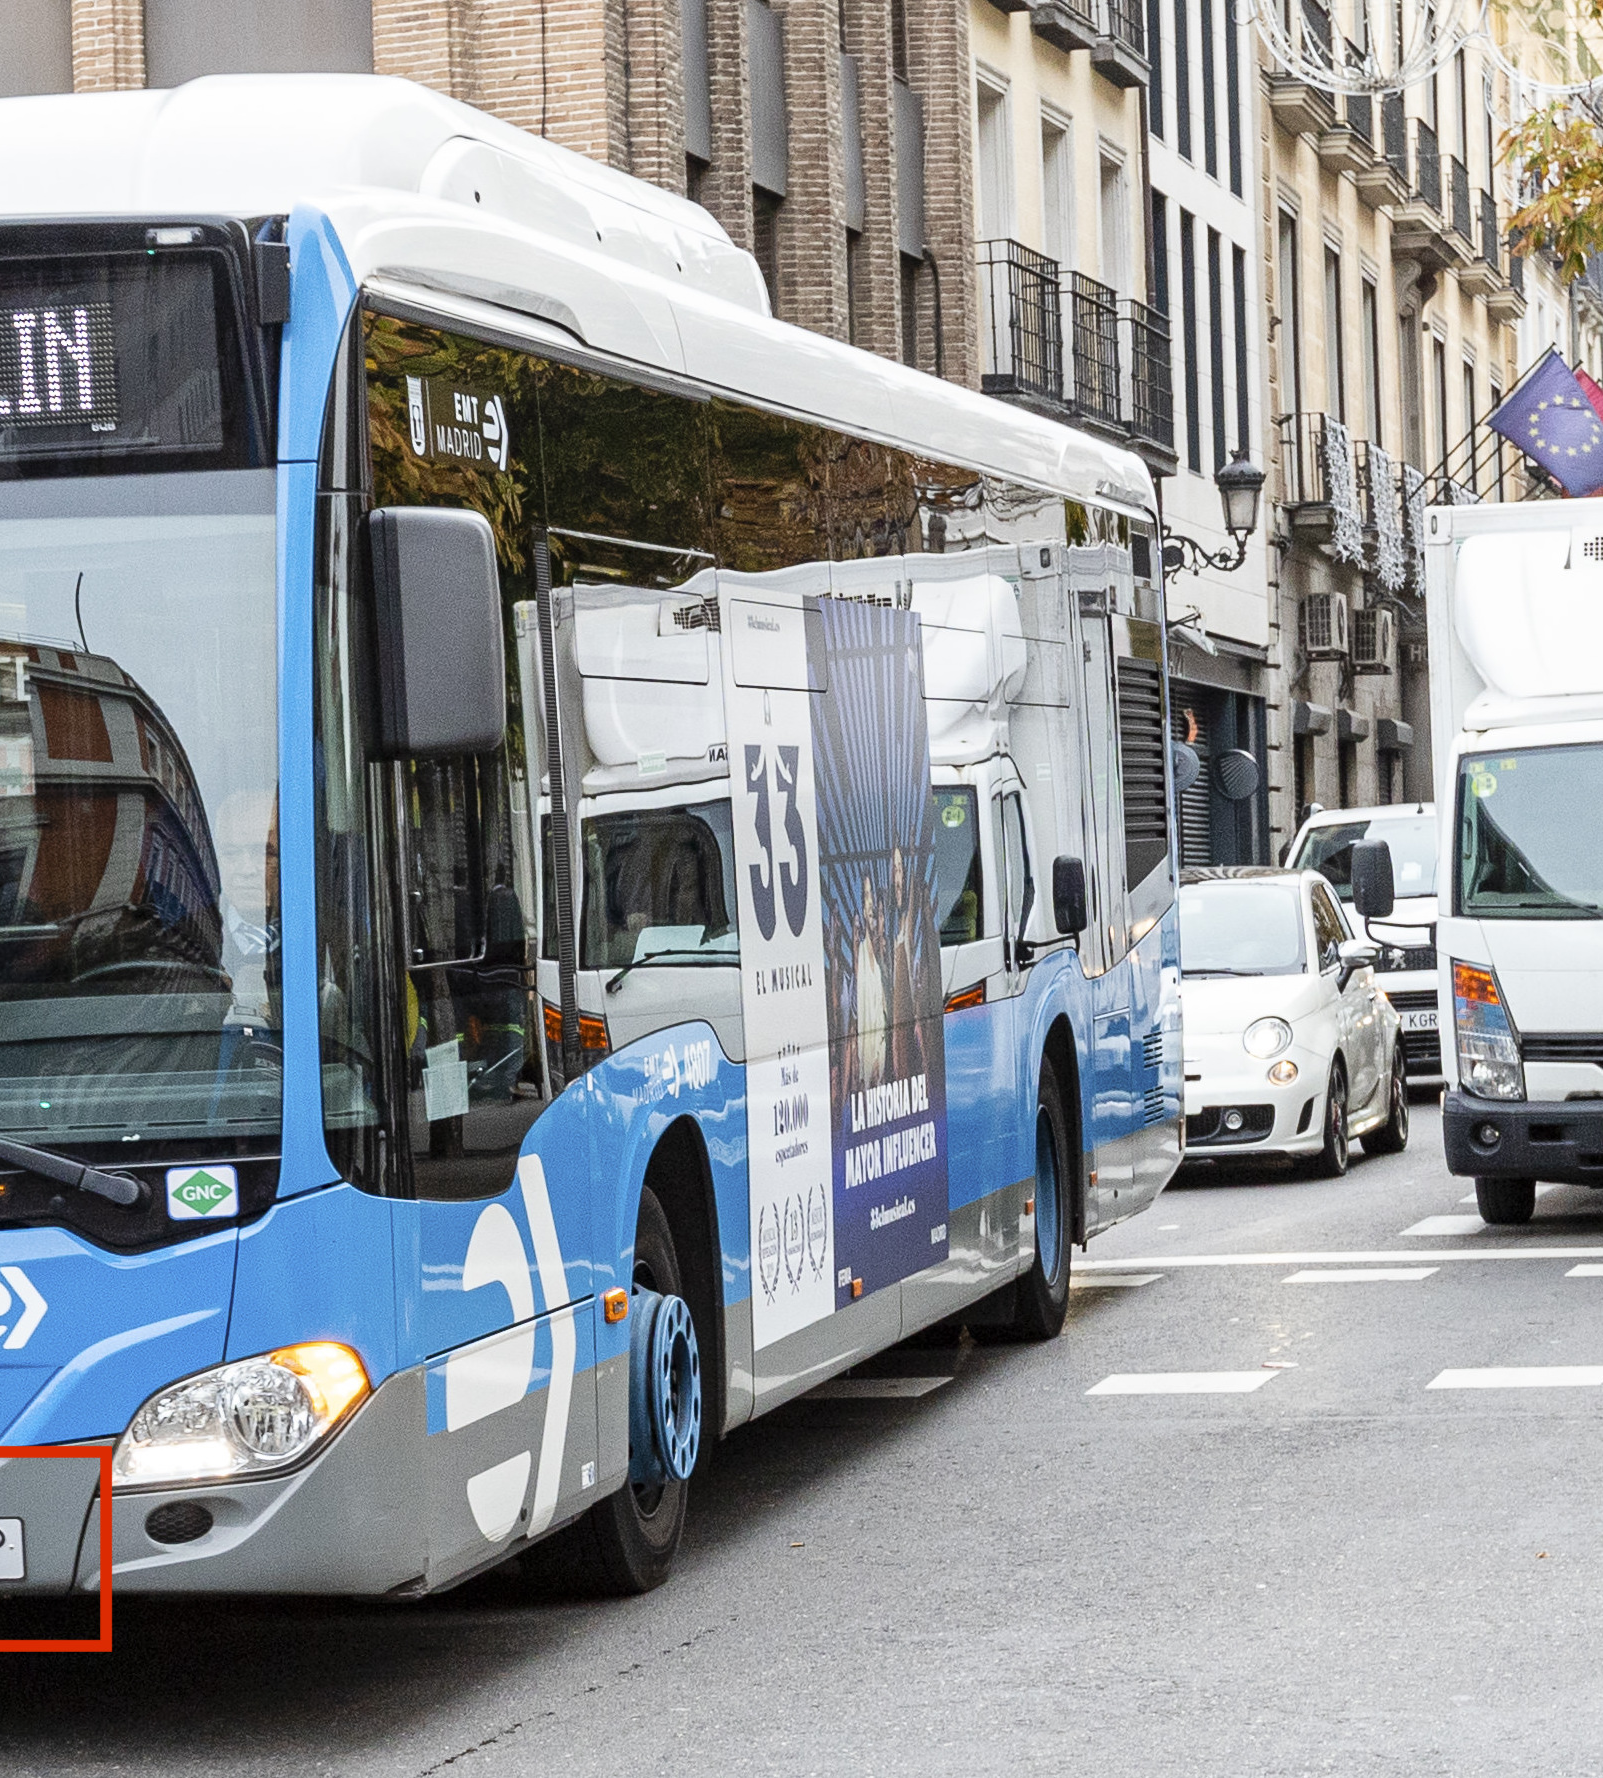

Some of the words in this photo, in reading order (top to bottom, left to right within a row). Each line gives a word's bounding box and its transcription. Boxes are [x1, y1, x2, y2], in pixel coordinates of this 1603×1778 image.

[453, 391, 479, 425] EMT
[435, 424, 482, 460] MADRID
[743, 744, 808, 942] 33
[756, 970, 767, 996] EL
[771, 963, 812, 993] MUSICAL
[1408, 1013, 1438, 1028] KGR
[643, 1053, 659, 1078] EMT
[684, 1039, 710, 1090] 4807
[851, 1091, 866, 1134] LA
[866, 1078, 911, 1129] HISTORIA
[911, 1073, 929, 1114] DEL
[845, 1139, 882, 1190] MAYOR
[882, 1120, 937, 1176] INFLUENCER
[181, 1184, 223, 1202] GNC
